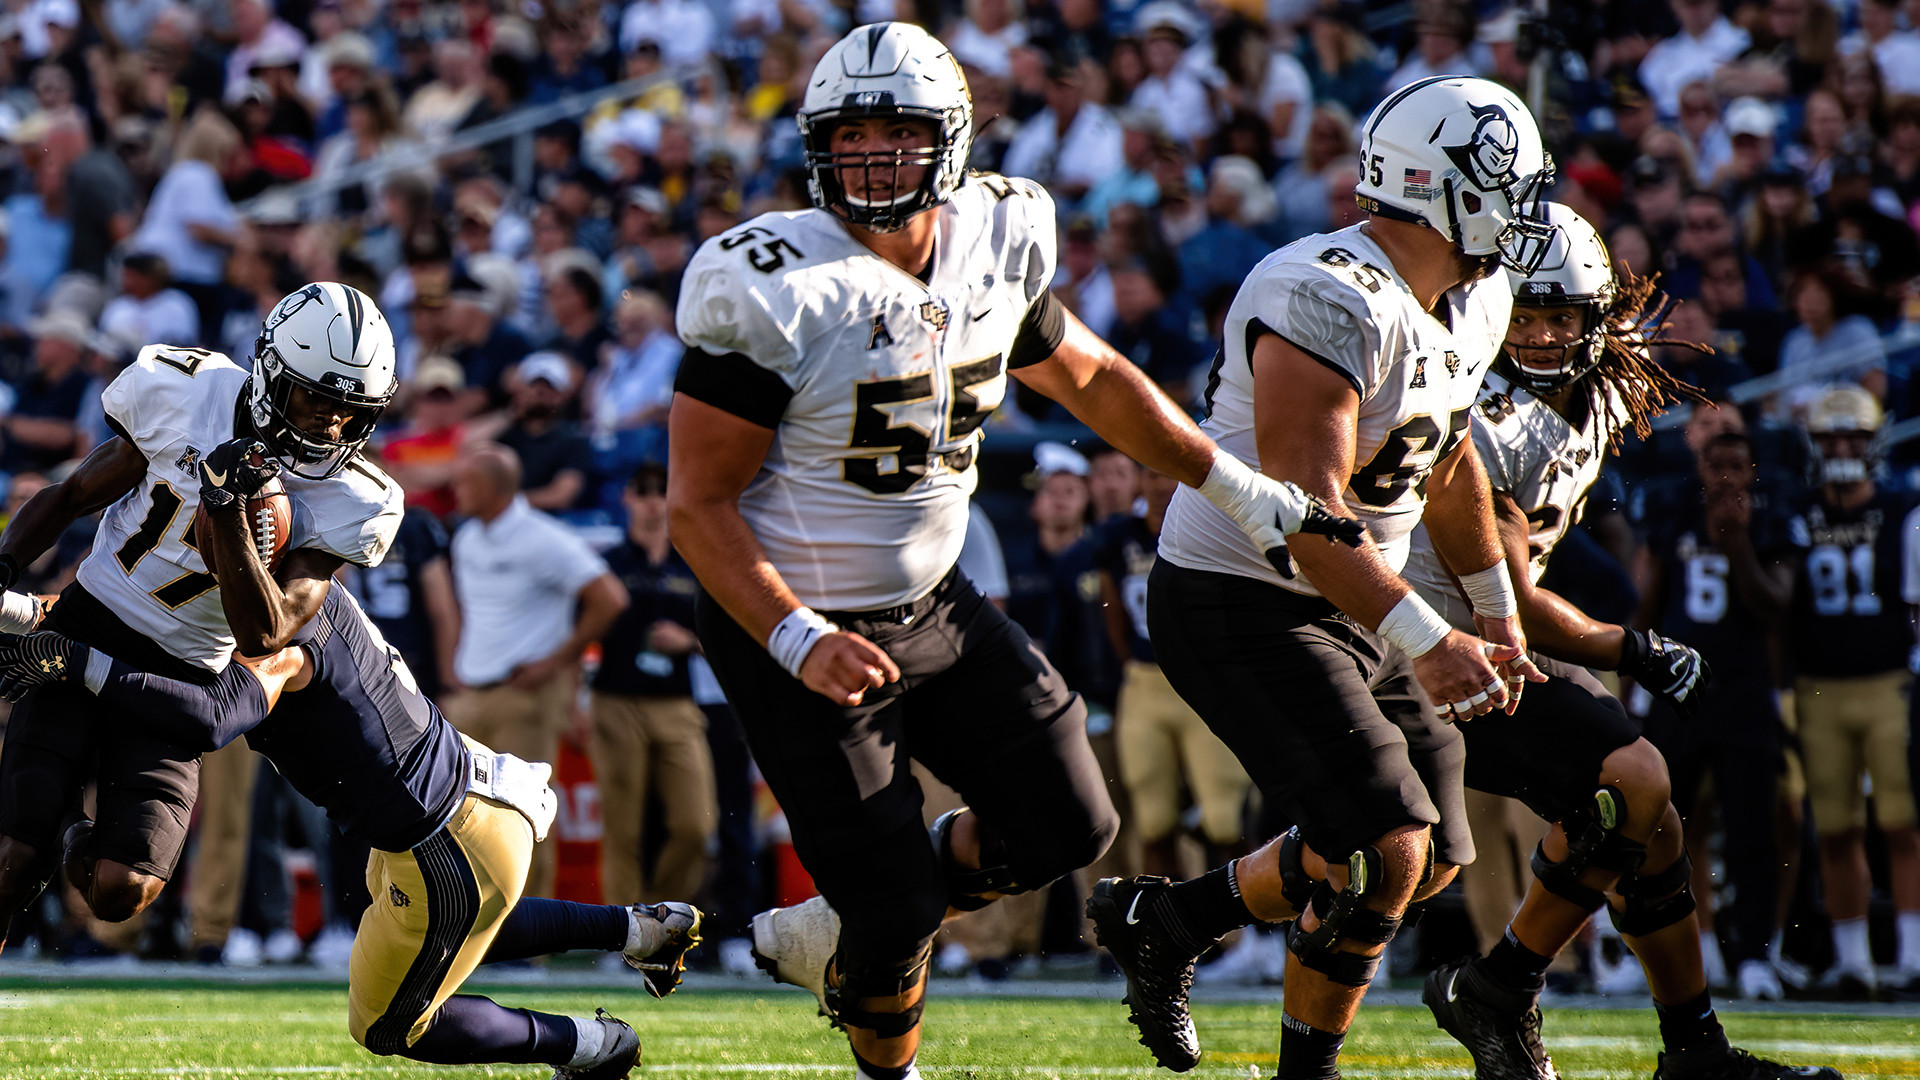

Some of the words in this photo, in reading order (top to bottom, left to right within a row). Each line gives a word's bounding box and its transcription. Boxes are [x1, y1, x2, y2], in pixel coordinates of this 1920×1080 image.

[1359, 149, 1385, 188] 65
[719, 227, 805, 274] 55
[1316, 247, 1392, 294] 65
[1530, 283, 1552, 294] 386
[335, 377, 356, 392] 305
[841, 352, 1003, 496] 55
[174, 444, 201, 480] A
